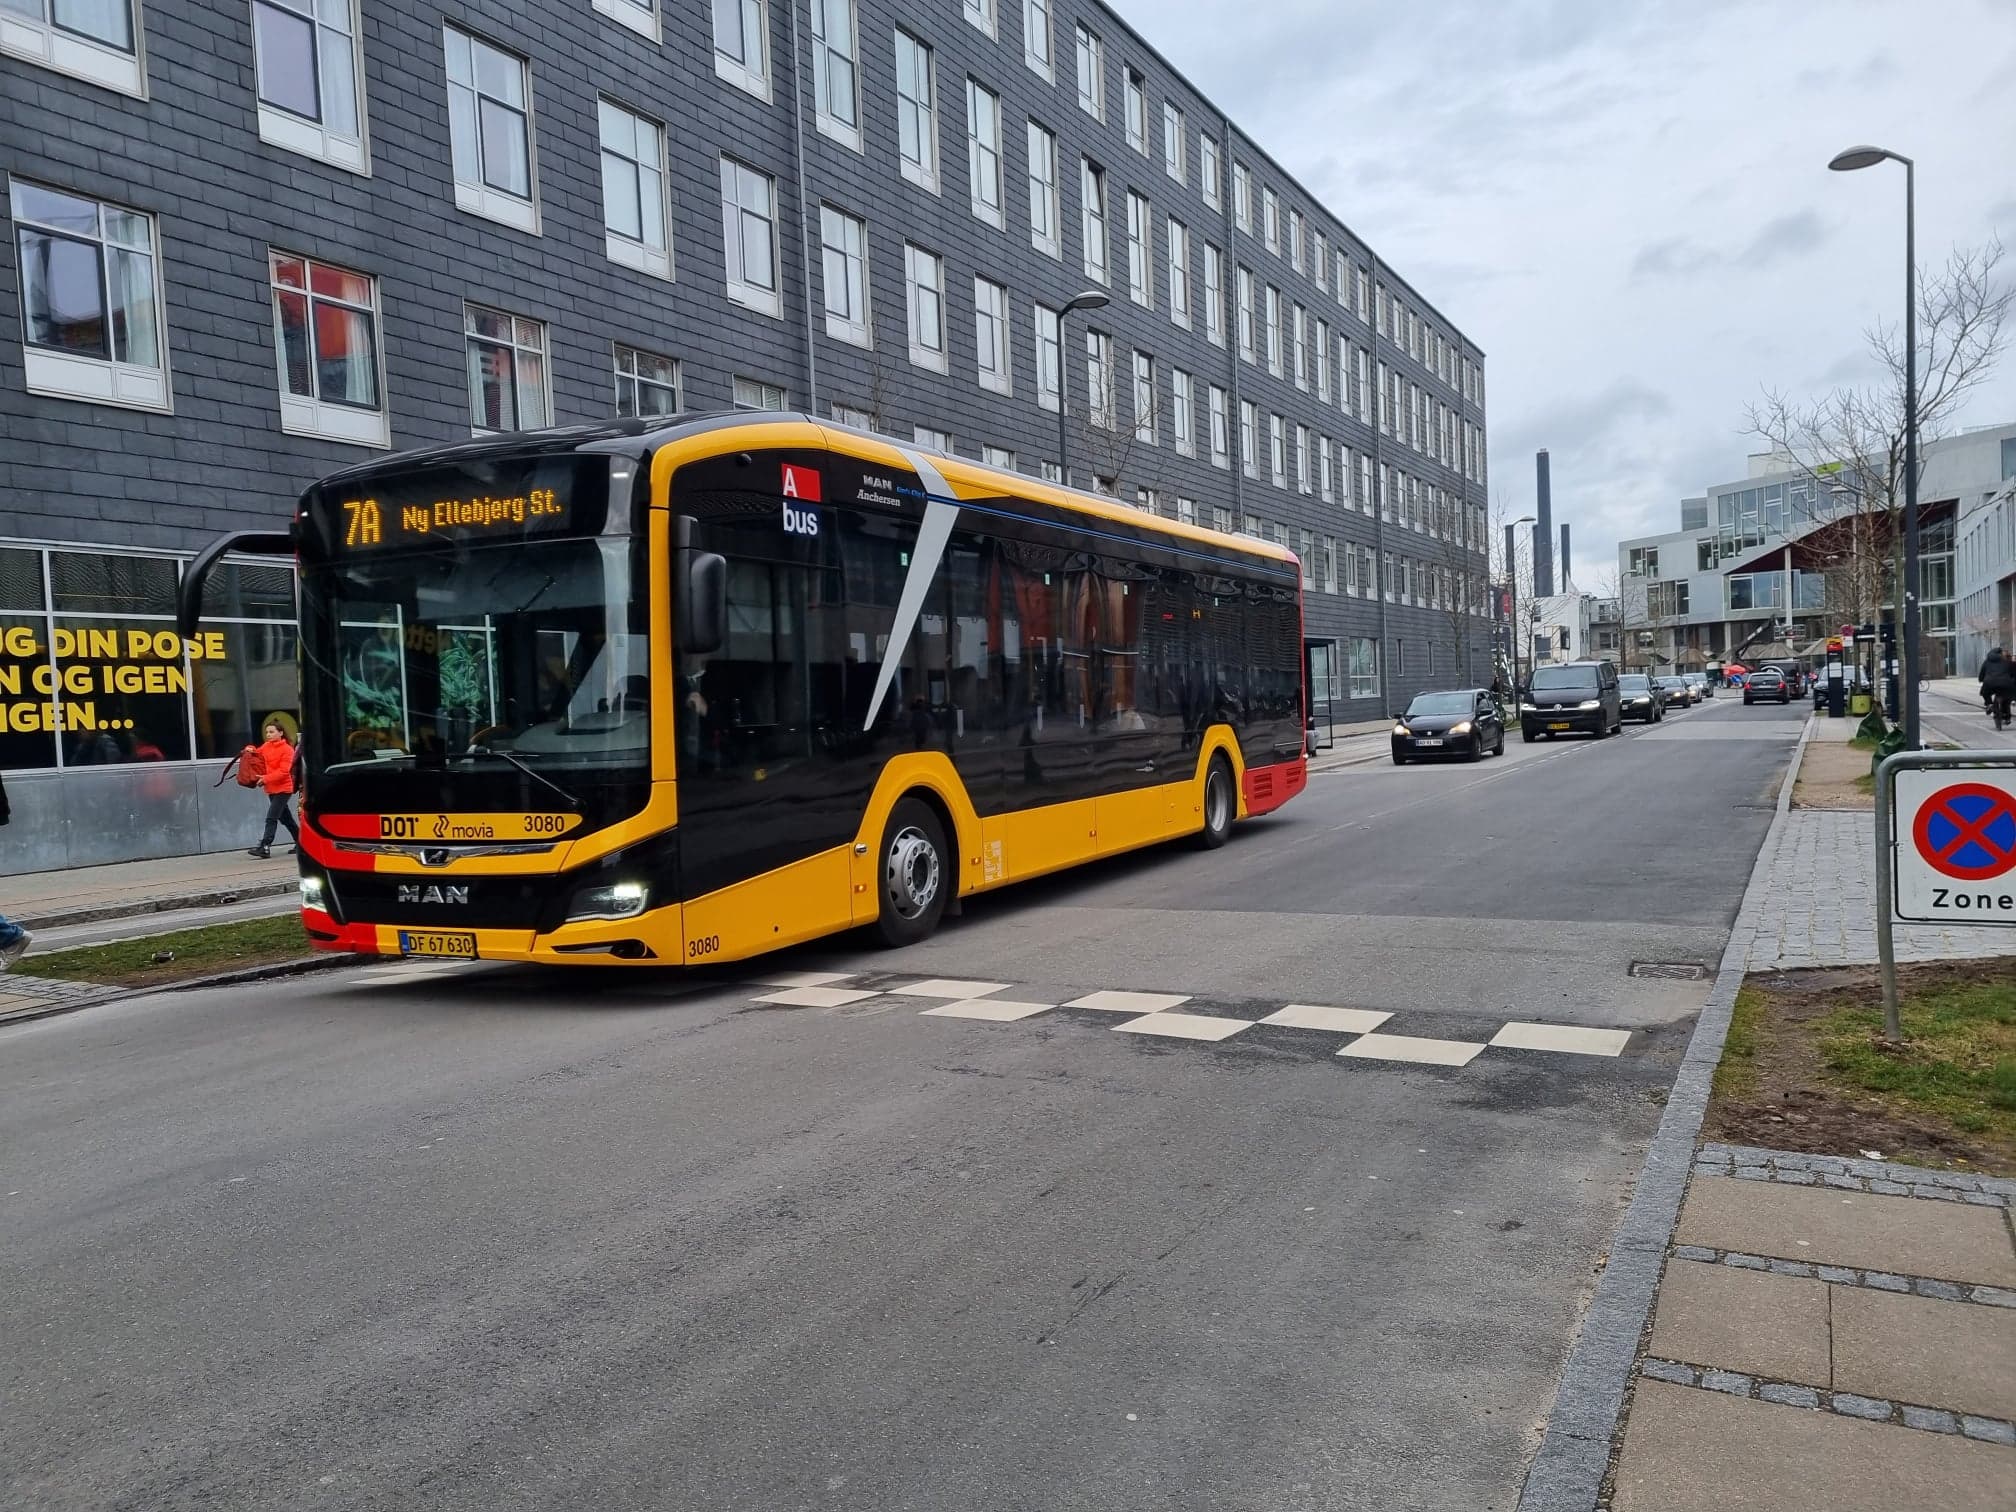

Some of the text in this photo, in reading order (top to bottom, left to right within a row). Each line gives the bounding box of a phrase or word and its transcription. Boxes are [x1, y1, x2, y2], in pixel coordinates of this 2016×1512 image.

[783, 468, 798, 497] A
[863, 474, 893, 491] MAN
[856, 488, 901, 507] Anchersen
[343, 488, 562, 547] 7A Ny Ellebjerg St.
[783, 502, 819, 536] bus
[0, 627, 37, 658] G
[53, 629, 119, 658] DIN
[32, 665, 94, 695] OG
[103, 665, 189, 695] IGEN
[380, 815, 494, 839] DOT movia
[523, 815, 566, 834] 3080
[398, 884, 469, 905] MAN
[1932, 888, 2014, 910] Zone
[408, 936, 472, 953] DF 67 630
[688, 935, 720, 958] 3080
